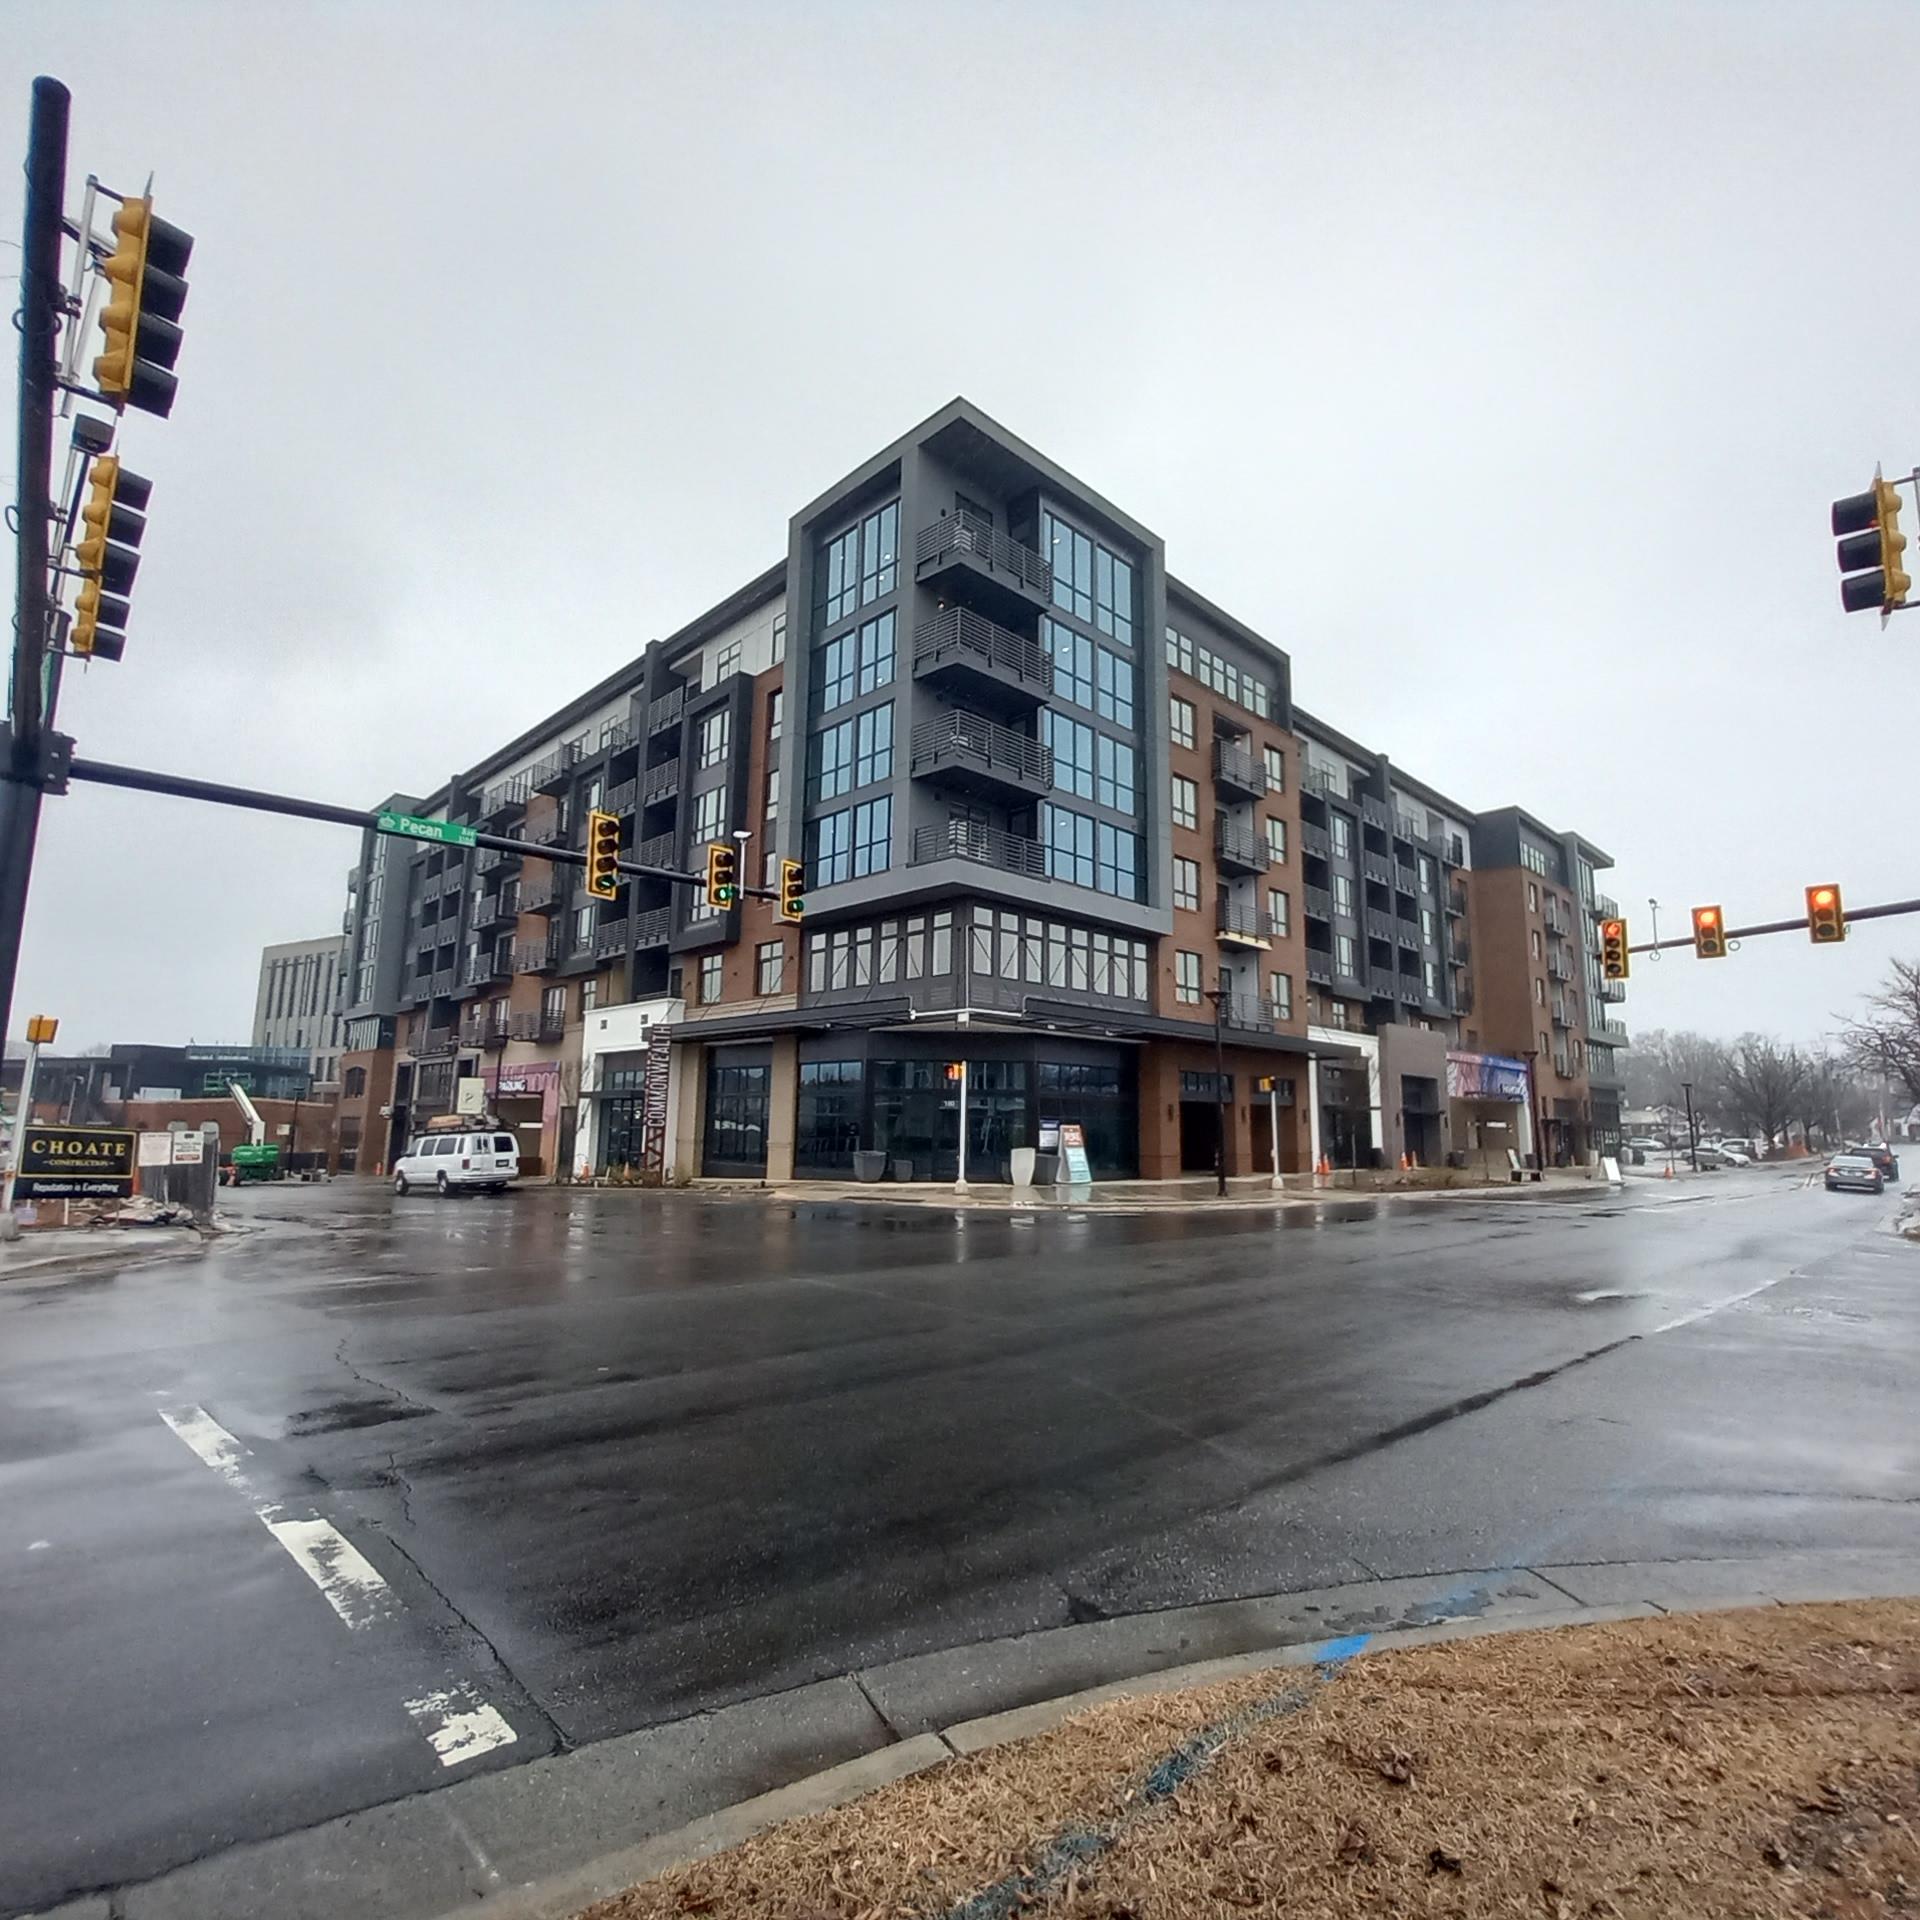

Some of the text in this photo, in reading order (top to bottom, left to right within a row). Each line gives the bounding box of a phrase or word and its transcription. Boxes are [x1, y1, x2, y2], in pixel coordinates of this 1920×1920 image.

[400, 817, 443, 838] Pecan
[647, 1025, 672, 1127] COMMONWEALTH
[31, 1139, 126, 1157] CHOATE
[32, 1182, 73, 1193] Reputation
[82, 1183, 120, 1193] Everything
